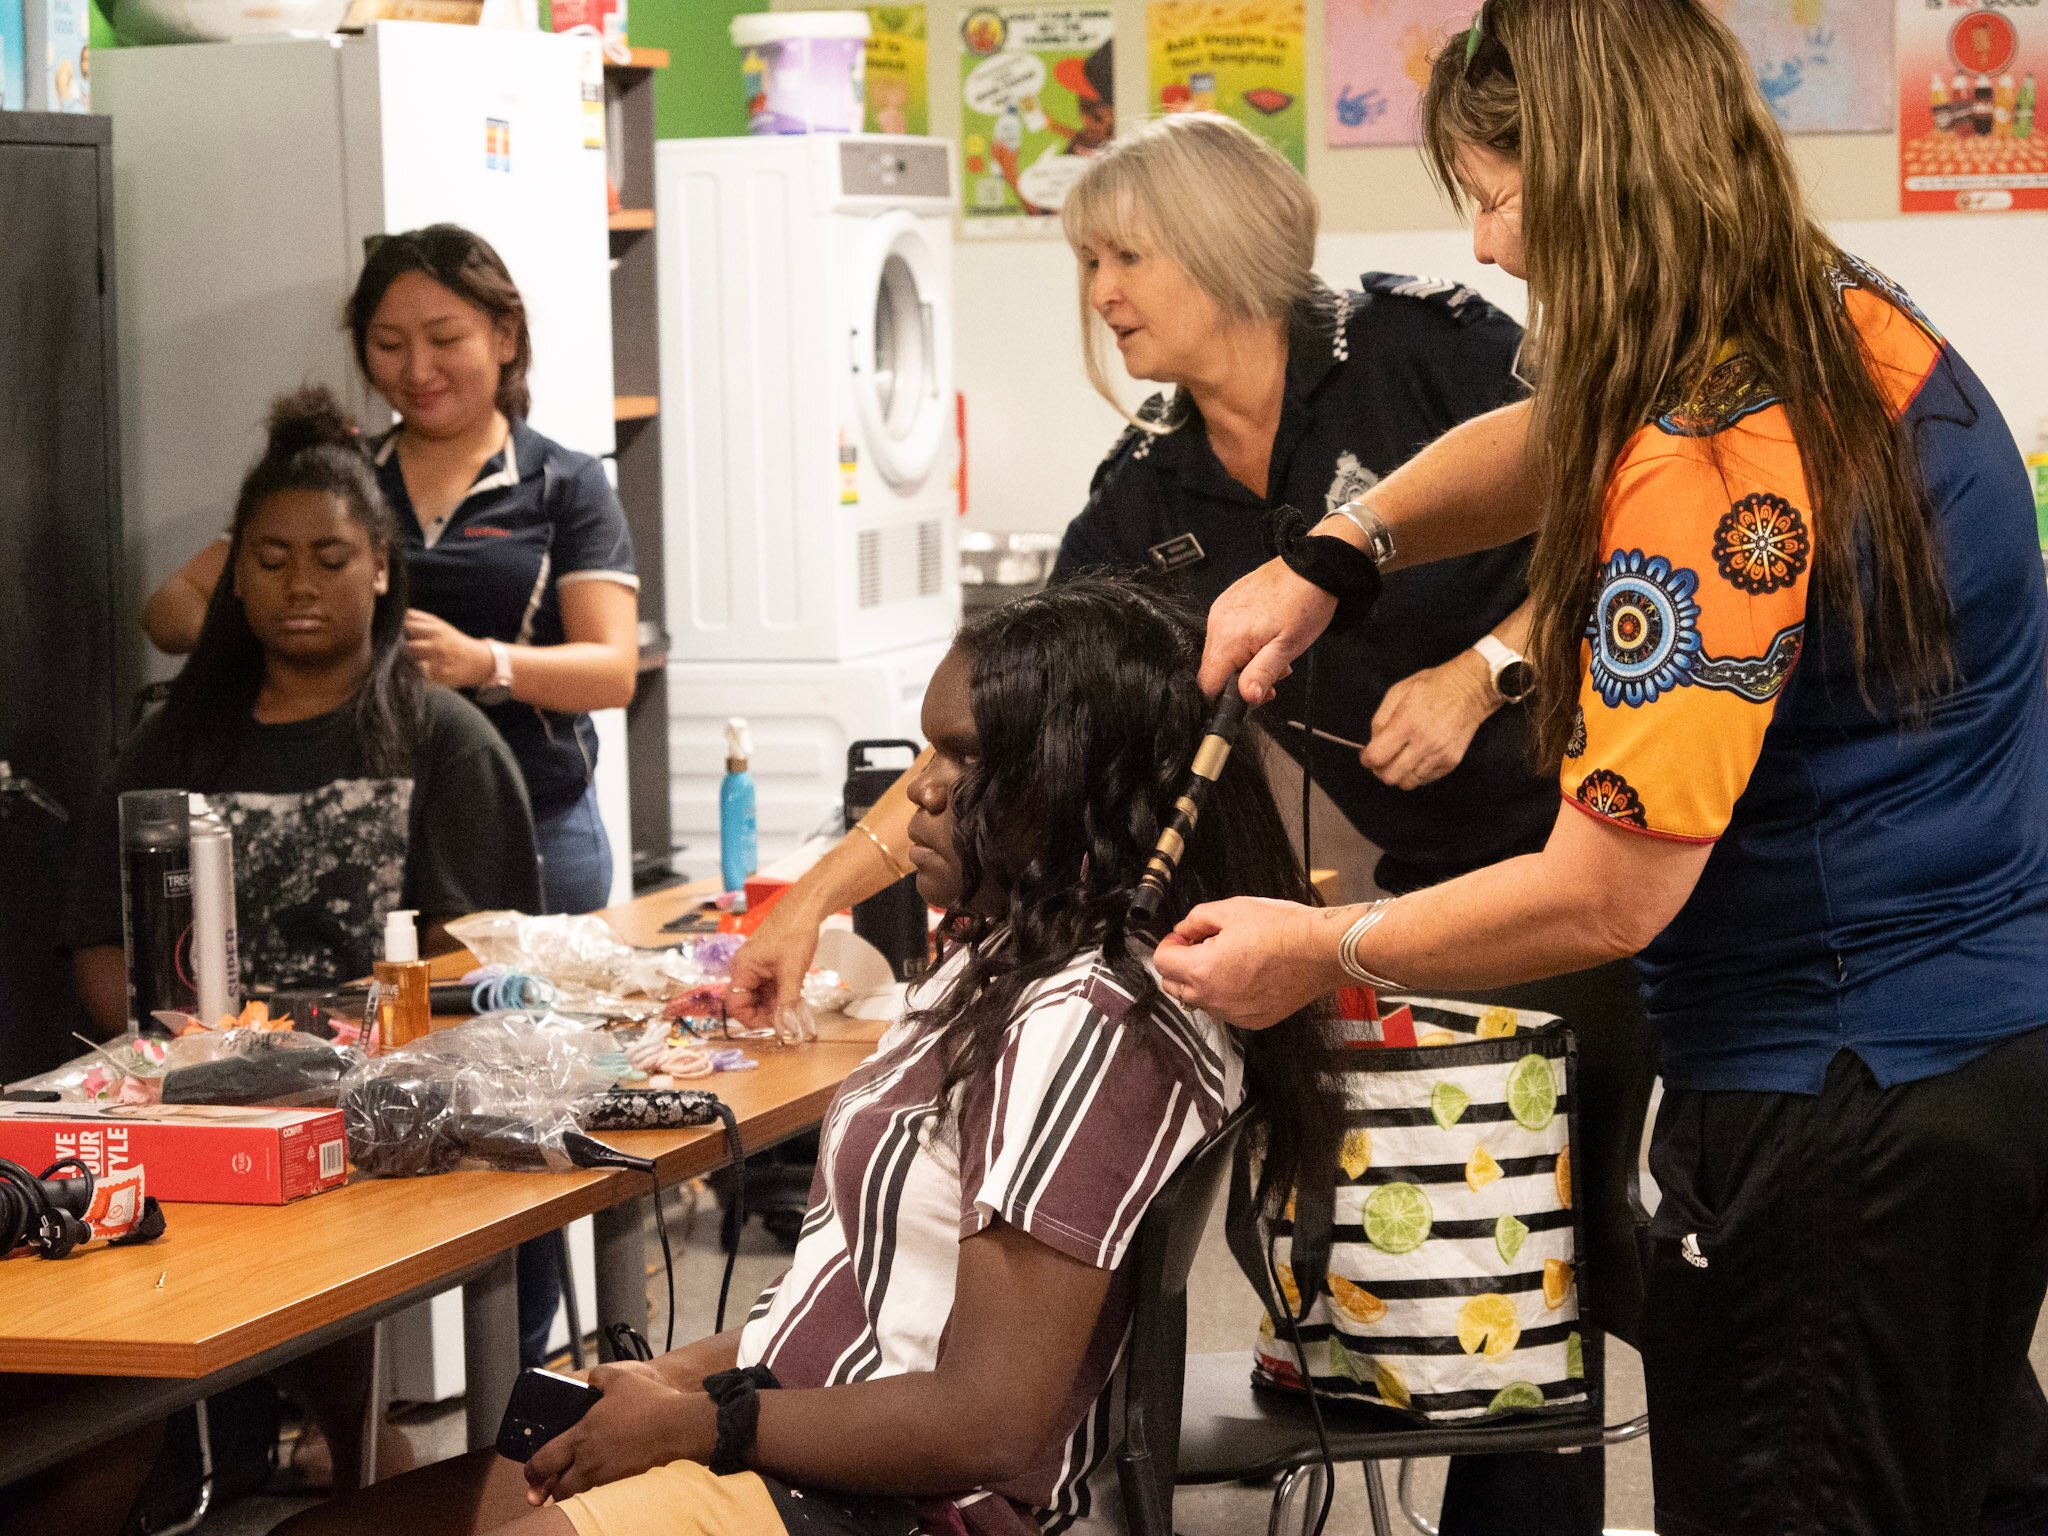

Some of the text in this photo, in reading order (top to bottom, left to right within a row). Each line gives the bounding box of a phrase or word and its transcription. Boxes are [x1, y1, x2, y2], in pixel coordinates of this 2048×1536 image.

[168, 874, 190, 887] TRES
[55, 1132, 76, 1179] OVE
[79, 1131, 101, 1177] OUR
[107, 1127, 129, 1177] TYLE
